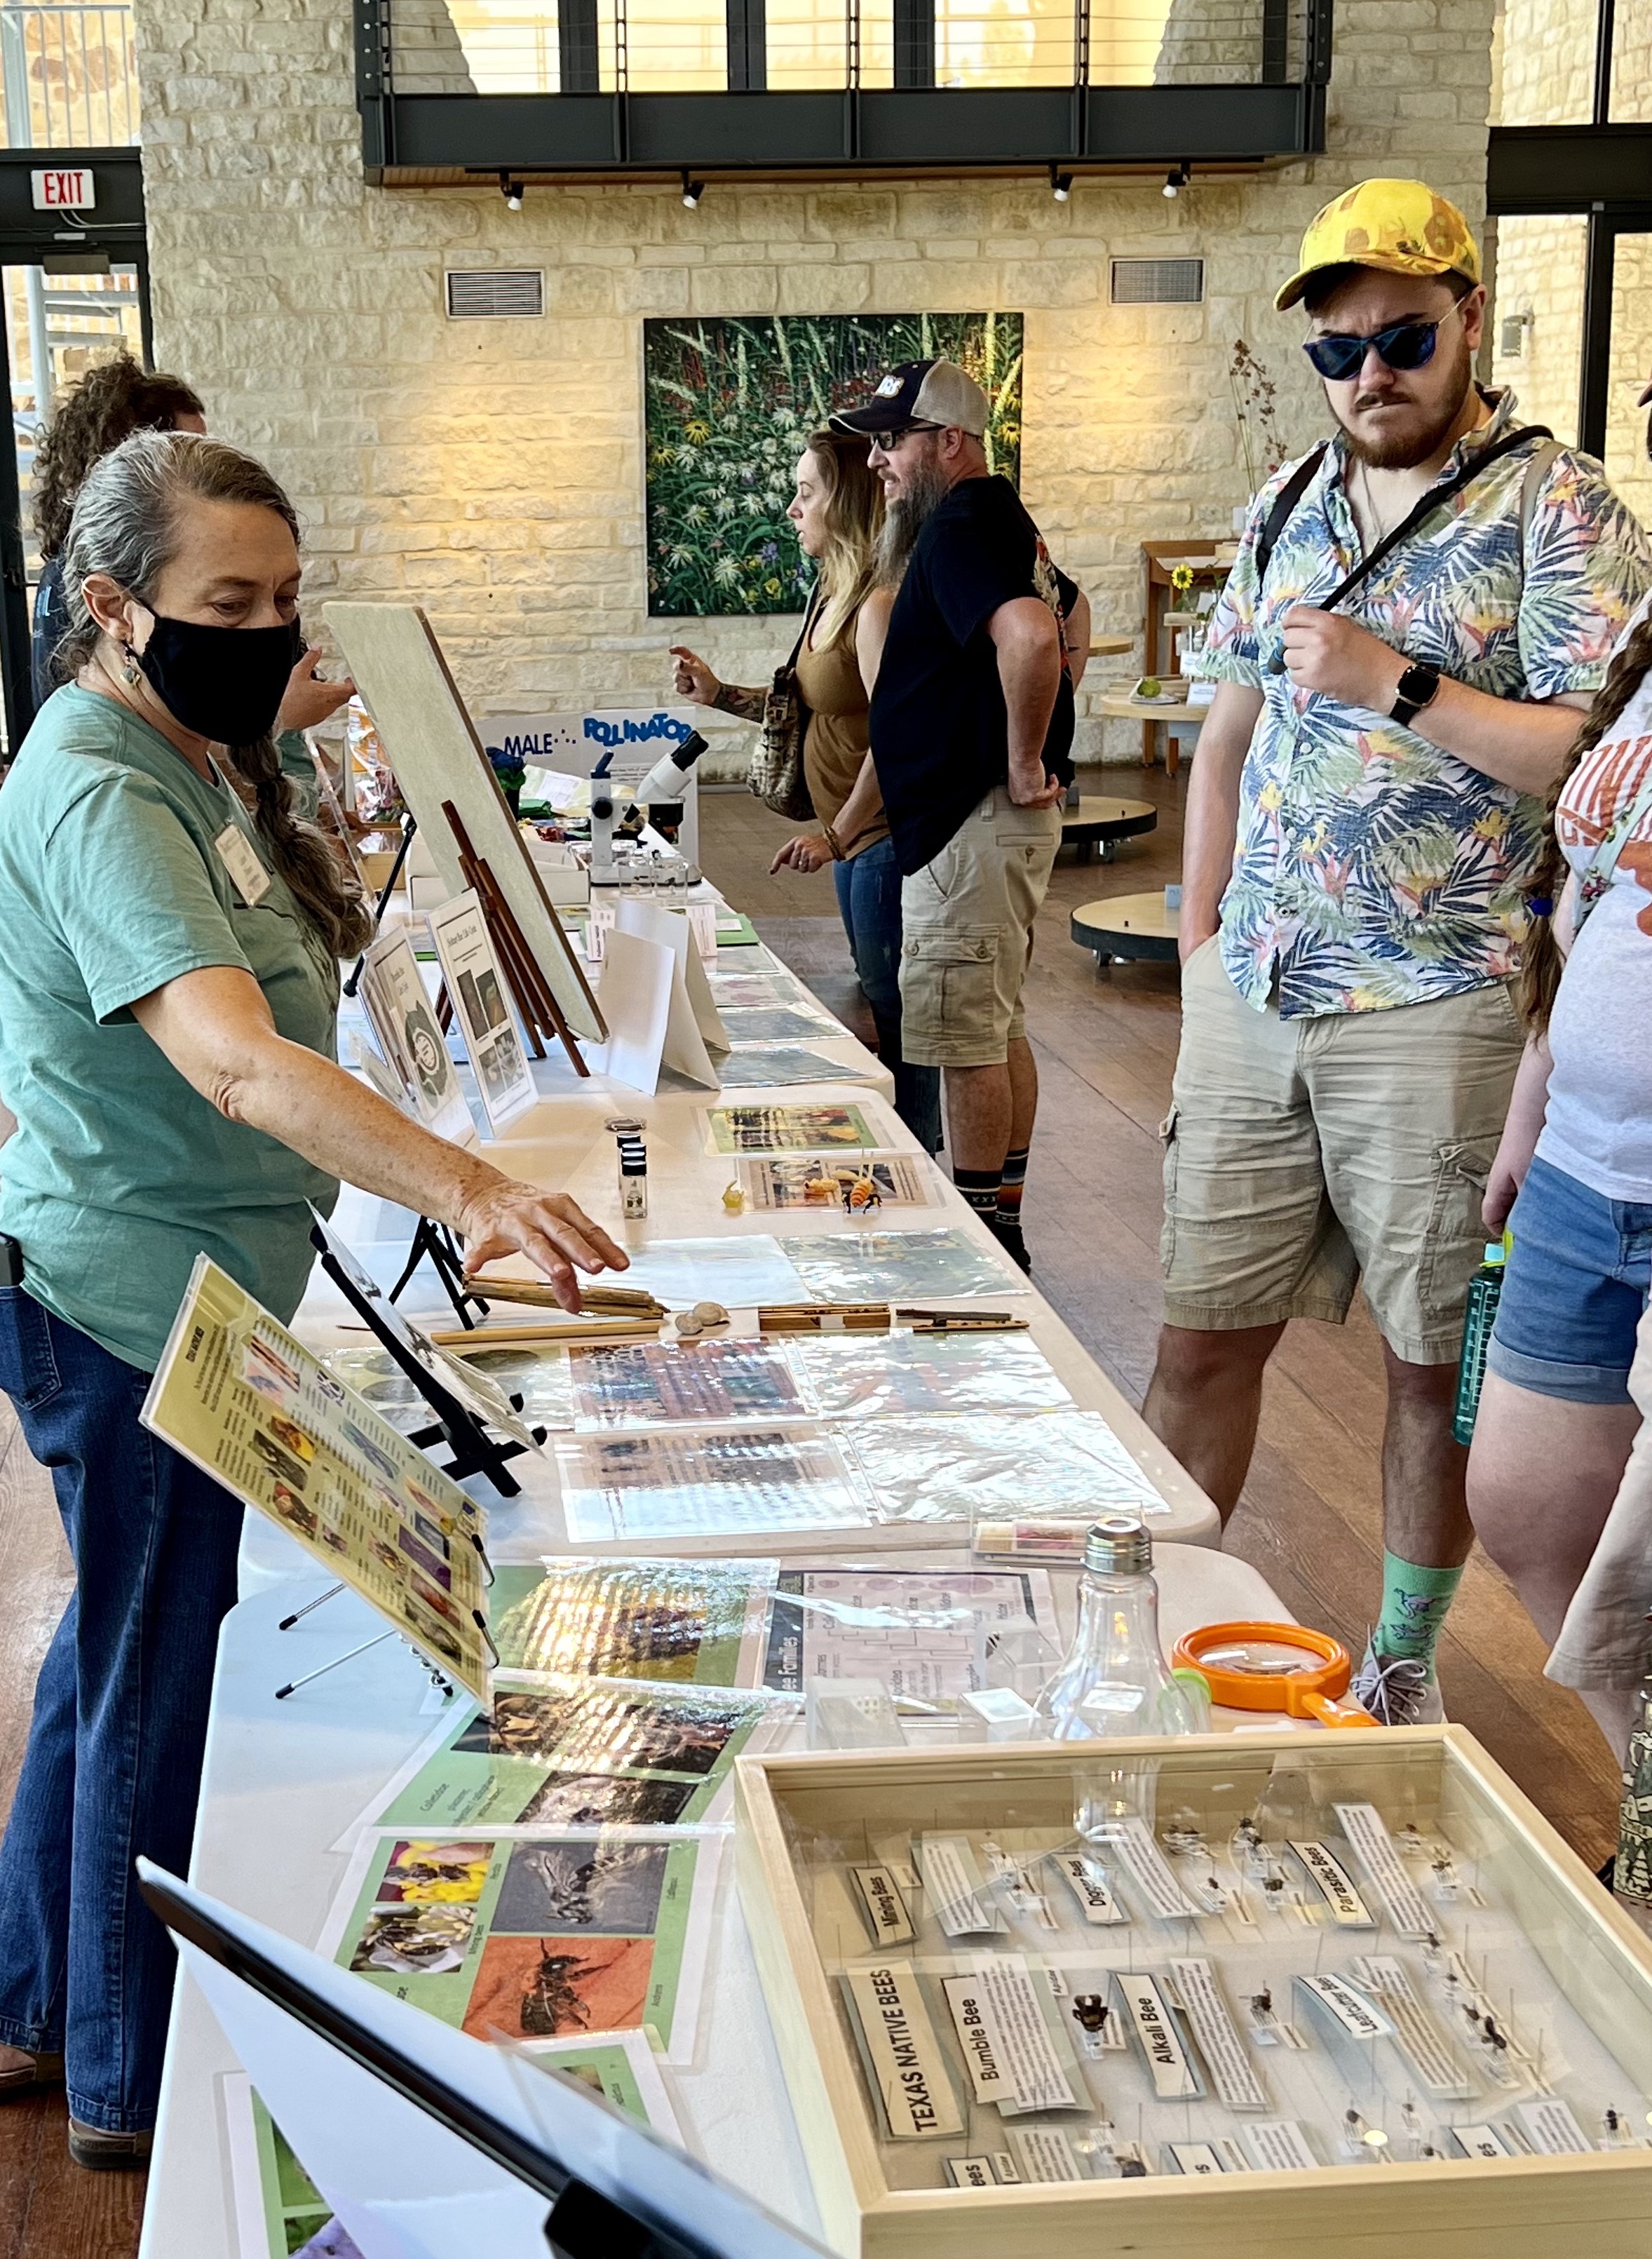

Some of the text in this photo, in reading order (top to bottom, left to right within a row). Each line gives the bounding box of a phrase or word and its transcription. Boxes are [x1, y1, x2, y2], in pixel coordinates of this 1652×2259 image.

[43, 172, 83, 204] EXIT
[504, 733, 553, 756] MALE
[1304, 1847, 1358, 1913] Parasitic Bees
[1138, 1998, 1160, 2021] Bee
[869, 1969, 938, 2133] TEXAS NATIVE BEES
[962, 1999, 1000, 2081] Bumble Bee
[1144, 2025, 1177, 2064] Alkali
[965, 2164, 986, 2187] ees
